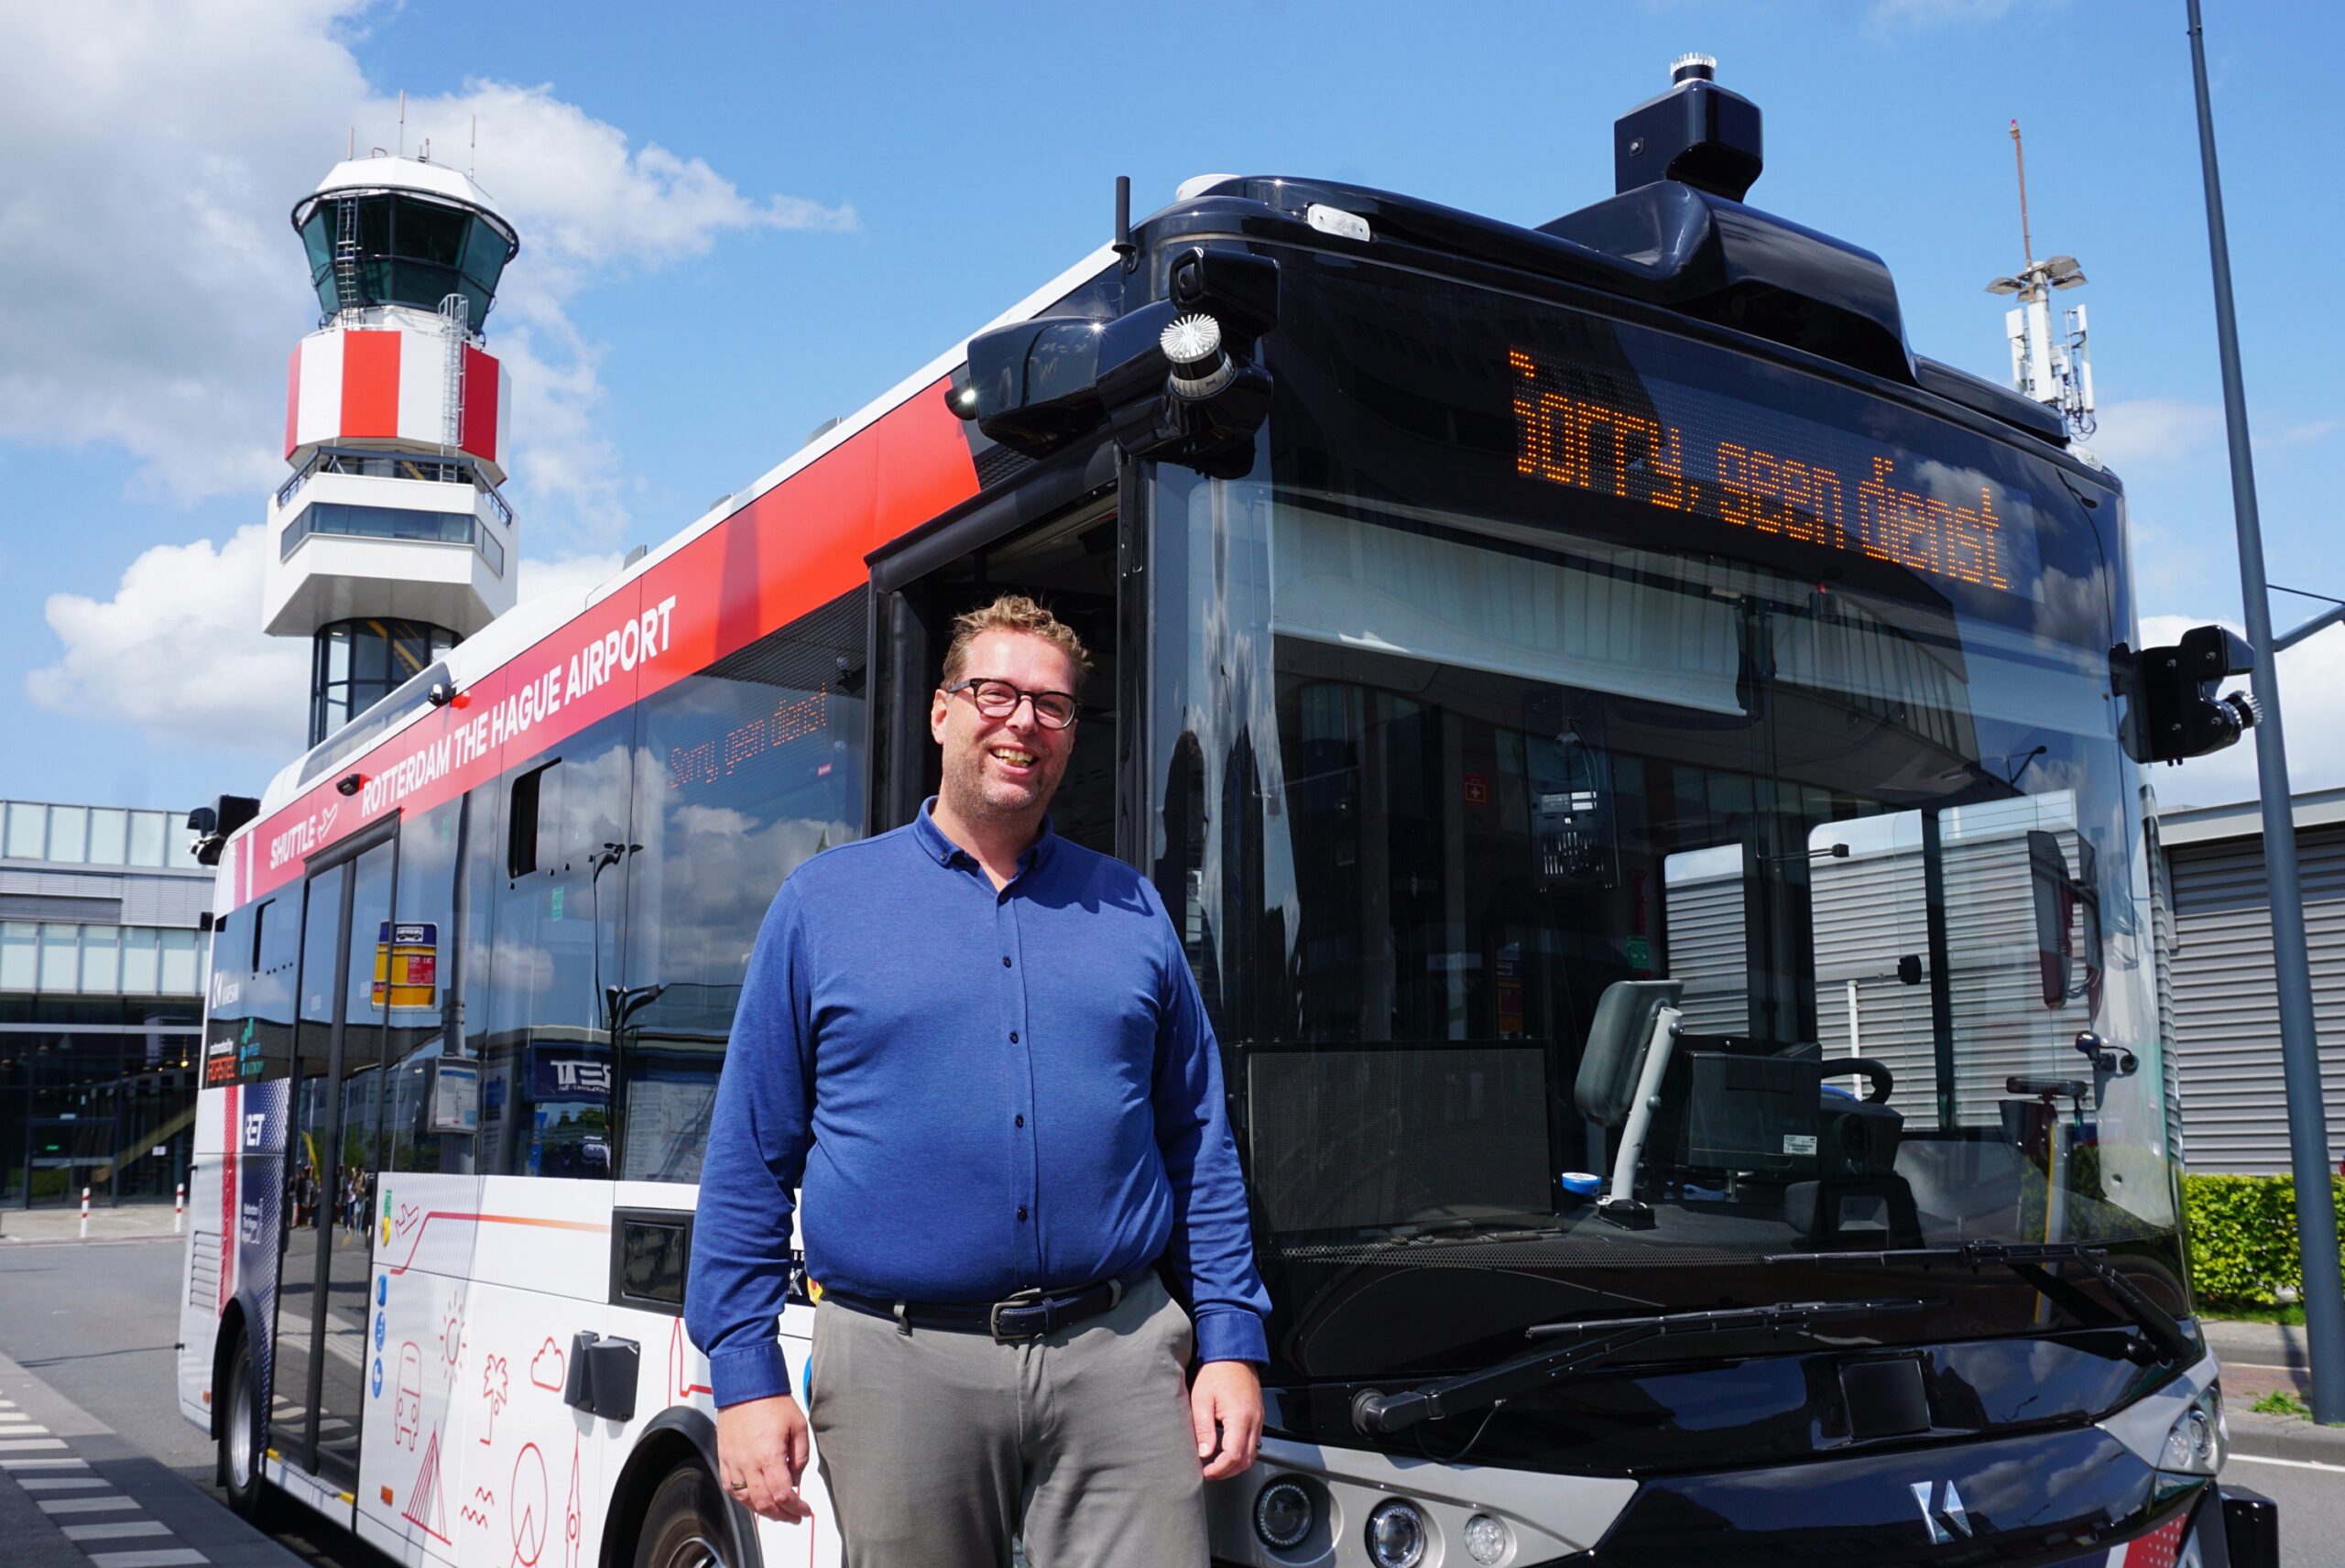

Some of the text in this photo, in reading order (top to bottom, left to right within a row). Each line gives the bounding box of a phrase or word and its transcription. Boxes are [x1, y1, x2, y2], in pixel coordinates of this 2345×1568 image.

[1718, 441, 1846, 550] geen
[1859, 456, 2009, 591] dienst
[269, 594, 677, 870] SHUTTLE ROTTERDAM THE HAGUE AIRPORT
[243, 1113, 266, 1146] RET
